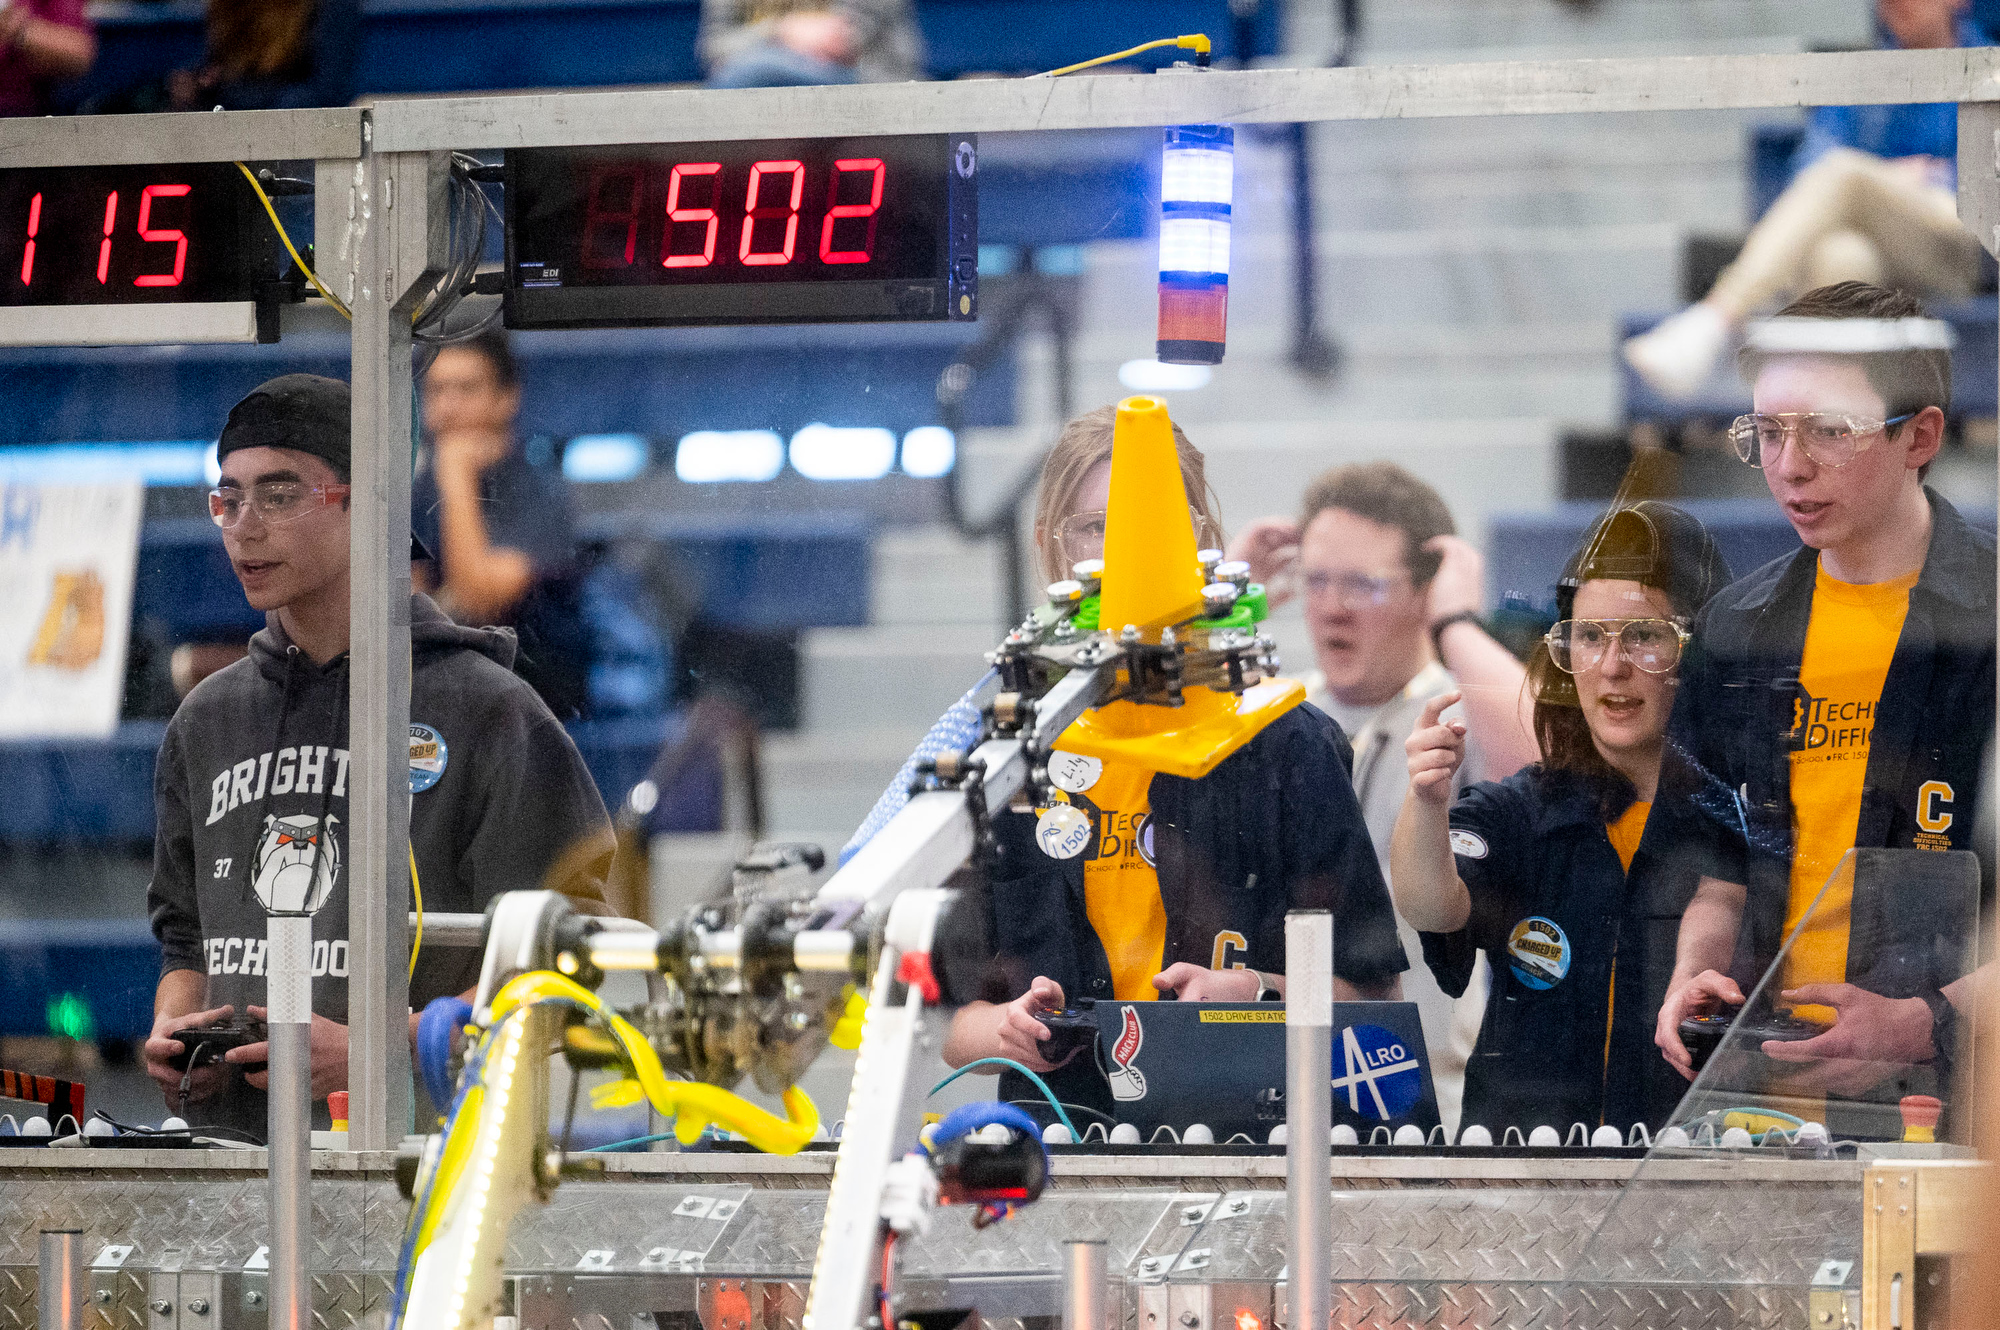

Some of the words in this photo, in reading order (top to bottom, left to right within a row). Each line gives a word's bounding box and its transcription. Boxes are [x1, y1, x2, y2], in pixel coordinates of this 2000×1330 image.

[543, 269, 559, 277] EDI
[410, 728, 428, 737] 707
[1808, 724, 1872, 749] DIFFI
[410, 745, 424, 757] GED
[1852, 751, 1868, 760] 150
[1061, 757, 1090, 779] Lily
[205, 746, 349, 826] BRIGHT
[1916, 780, 1955, 833] C
[1102, 810, 1147, 835] TEC
[1061, 824, 1091, 854] 1502
[1100, 835, 1138, 858] DIF
[214, 858, 232, 878] 37
[1535, 922, 1556, 937] 1502
[1517, 938, 1550, 955] CHARGED
[1550, 946, 1561, 958] UP
[1204, 1012, 1223, 1020] 1502
[1225, 1012, 1253, 1020] DRIVE
[1256, 1012, 1286, 1021] STATIO
[1118, 1038, 1136, 1060] HACK
[1128, 1020, 1137, 1039] CLUB
[1331, 1026, 1419, 1120] ALRO
